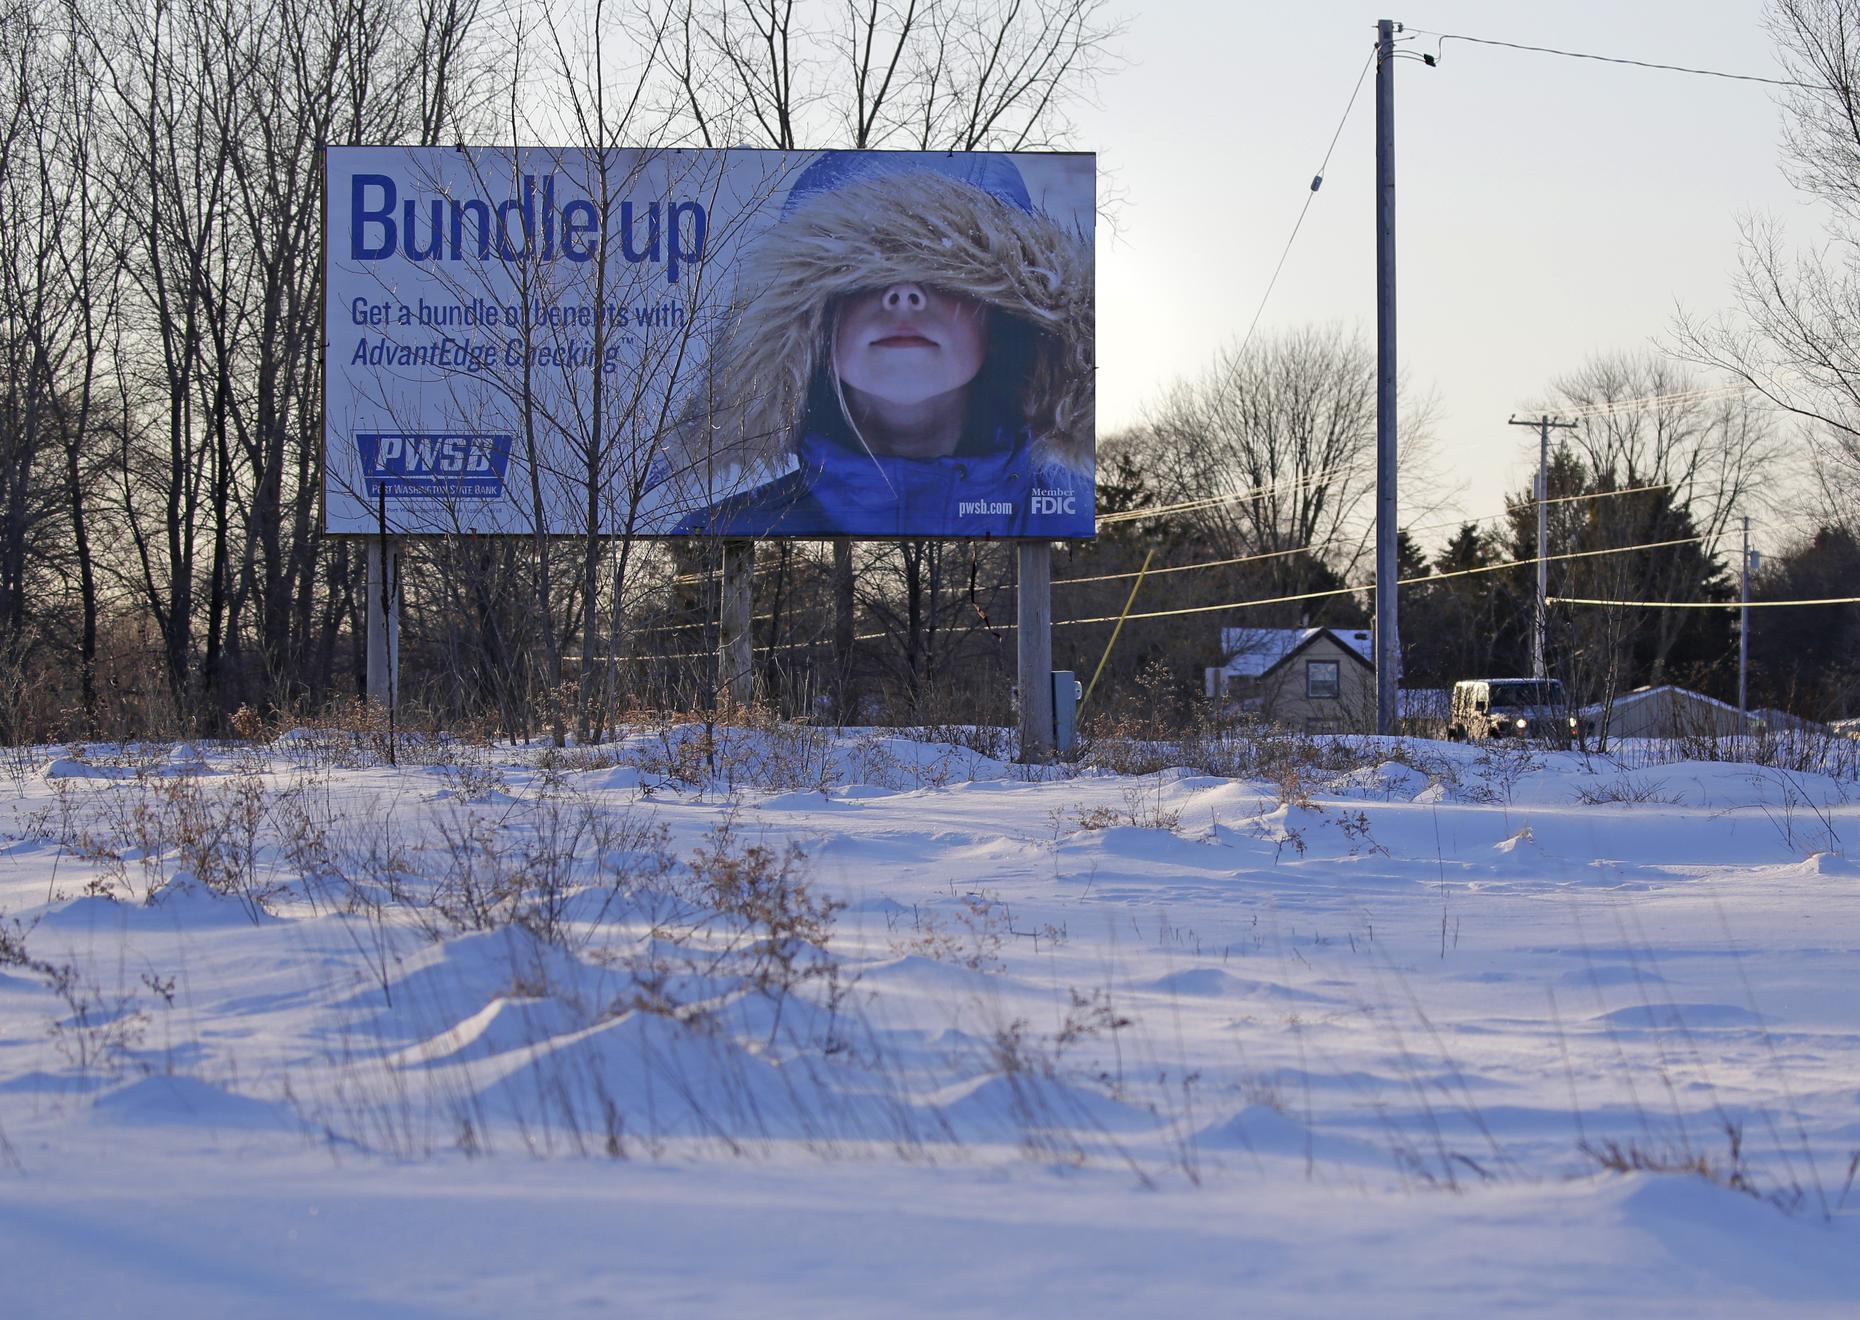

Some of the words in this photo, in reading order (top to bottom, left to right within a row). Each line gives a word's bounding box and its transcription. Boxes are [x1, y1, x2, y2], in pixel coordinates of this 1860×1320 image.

[351, 174, 598, 264] Bundle
[621, 201, 706, 284] up
[352, 296, 392, 327] Get
[398, 304, 411, 326] a
[419, 298, 498, 327] bundle
[636, 299, 684, 328] with
[351, 338, 496, 372] AdvantEdge
[376, 437, 493, 471] PWSB
[372, 484, 392, 495] PRT
[1031, 488, 1075, 497] Member
[959, 499, 1013, 517] pwsb.com
[1031, 497, 1076, 514] FDIC
